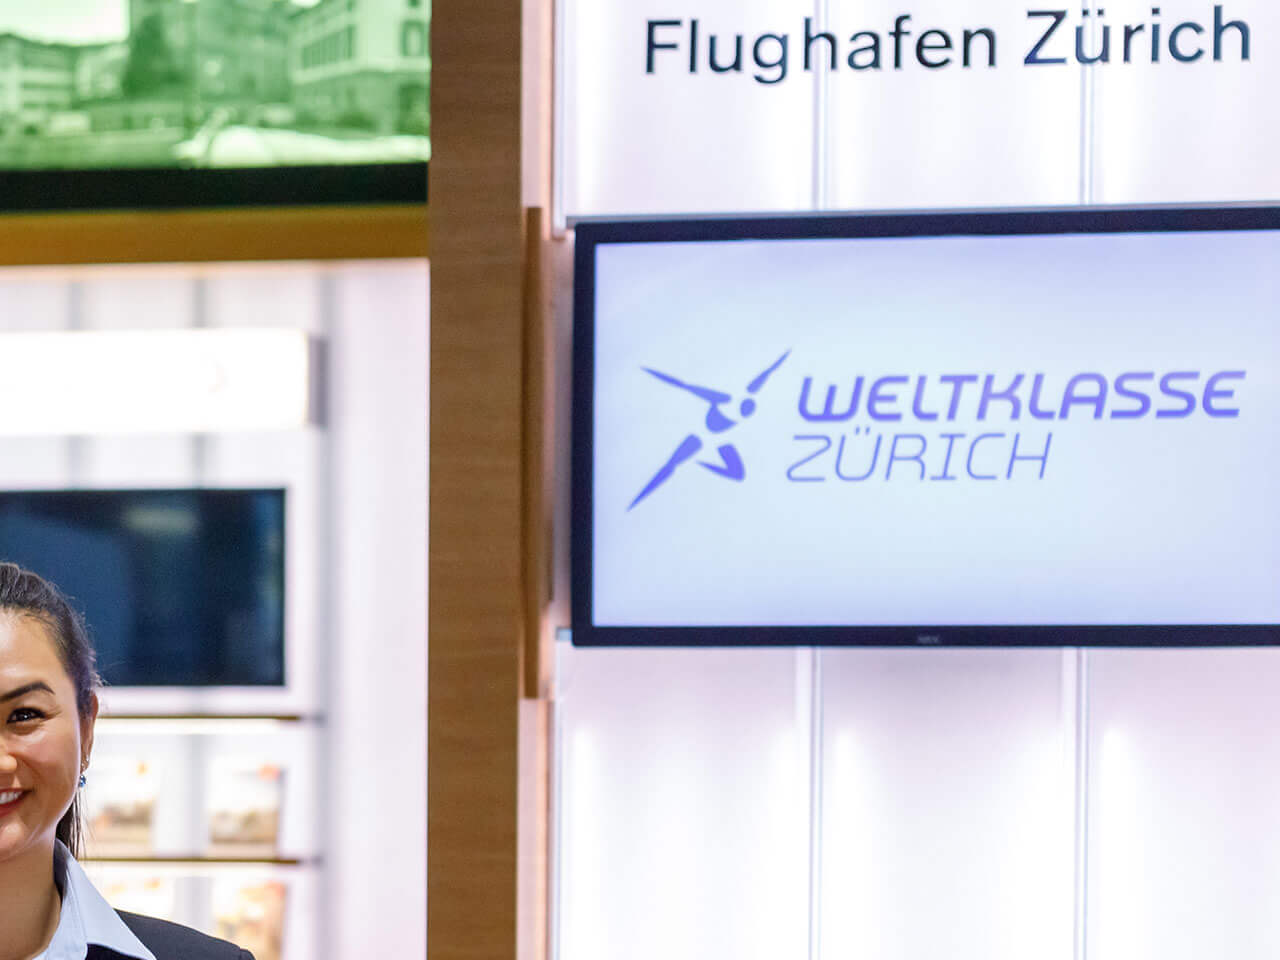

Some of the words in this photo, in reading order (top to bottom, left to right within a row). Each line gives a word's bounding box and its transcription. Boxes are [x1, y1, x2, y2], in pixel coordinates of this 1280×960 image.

[646, 14, 996, 85] Flughafen
[1023, 6, 1249, 64] Zürich
[797, 370, 1246, 423] WELTKLASSE
[785, 426, 1053, 483] ZÜRICH
